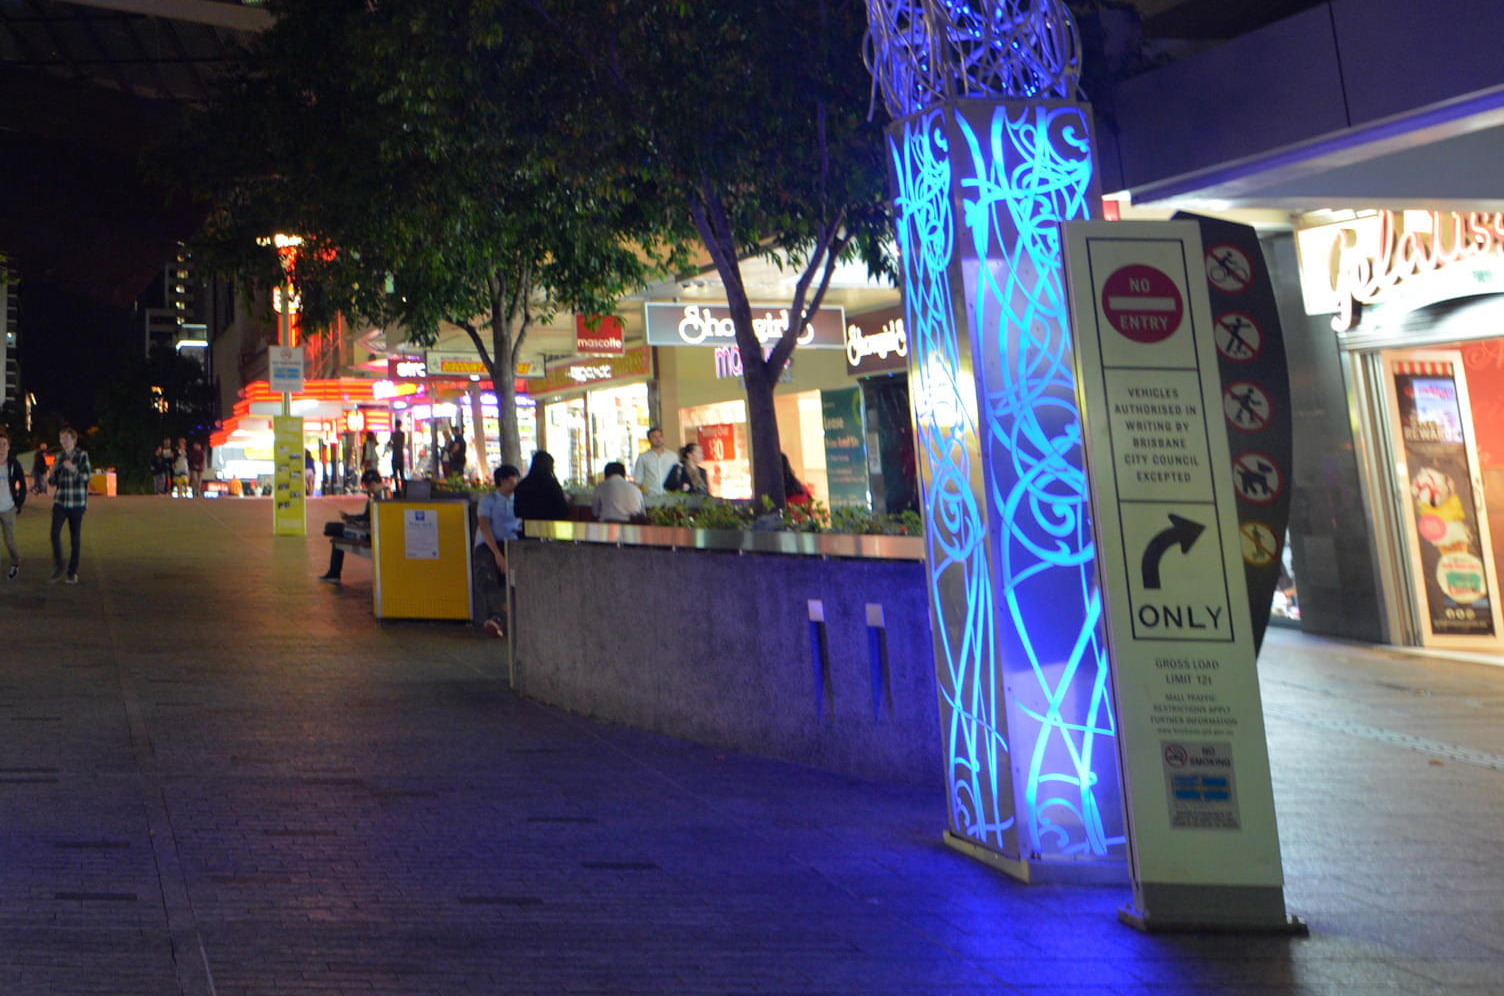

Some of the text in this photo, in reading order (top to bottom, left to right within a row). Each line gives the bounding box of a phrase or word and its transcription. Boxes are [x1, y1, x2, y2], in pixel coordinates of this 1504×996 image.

[1129, 277, 1151, 293] NO
[1119, 314, 1168, 332] ENTRY
[577, 337, 622, 349] mascotte
[1128, 387, 1179, 398] VEHICLES
[1114, 404, 1197, 415] AUTHORISED IN
[1126, 421, 1190, 432] WRITING BY
[1133, 438, 1186, 449] BRISBANE
[1124, 454, 1199, 467] CITY COUNCIL
[1136, 471, 1192, 483] EXCEPTED
[1138, 604, 1223, 630] ONLY
[1155, 658, 1220, 670] GROSS LOAD
[1165, 674, 1192, 685] LIMIT
[1201, 746, 1216, 756] NO
